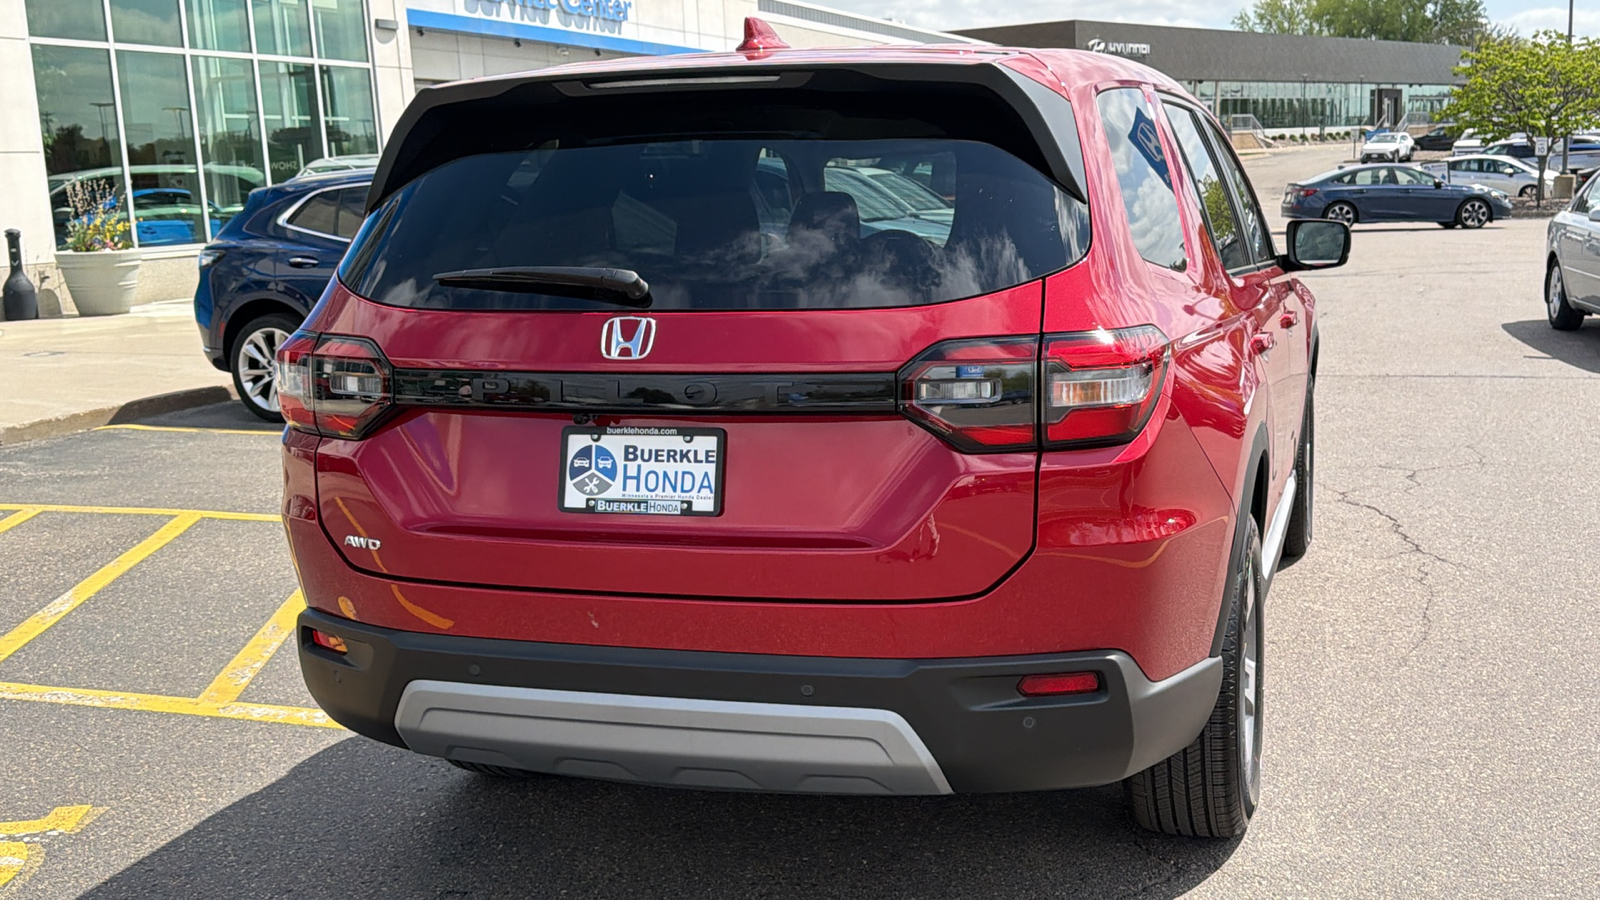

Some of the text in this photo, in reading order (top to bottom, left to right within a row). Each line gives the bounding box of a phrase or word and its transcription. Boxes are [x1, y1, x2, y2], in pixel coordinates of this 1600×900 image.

[472, 377, 795, 404] PILOT
[606, 427, 678, 435] buerklehonda.com
[624, 445, 716, 463] BUERKLE
[622, 463, 714, 494] HONDA
[597, 500, 679, 513] BUERKLE HONDA
[344, 535, 381, 550] AWD
